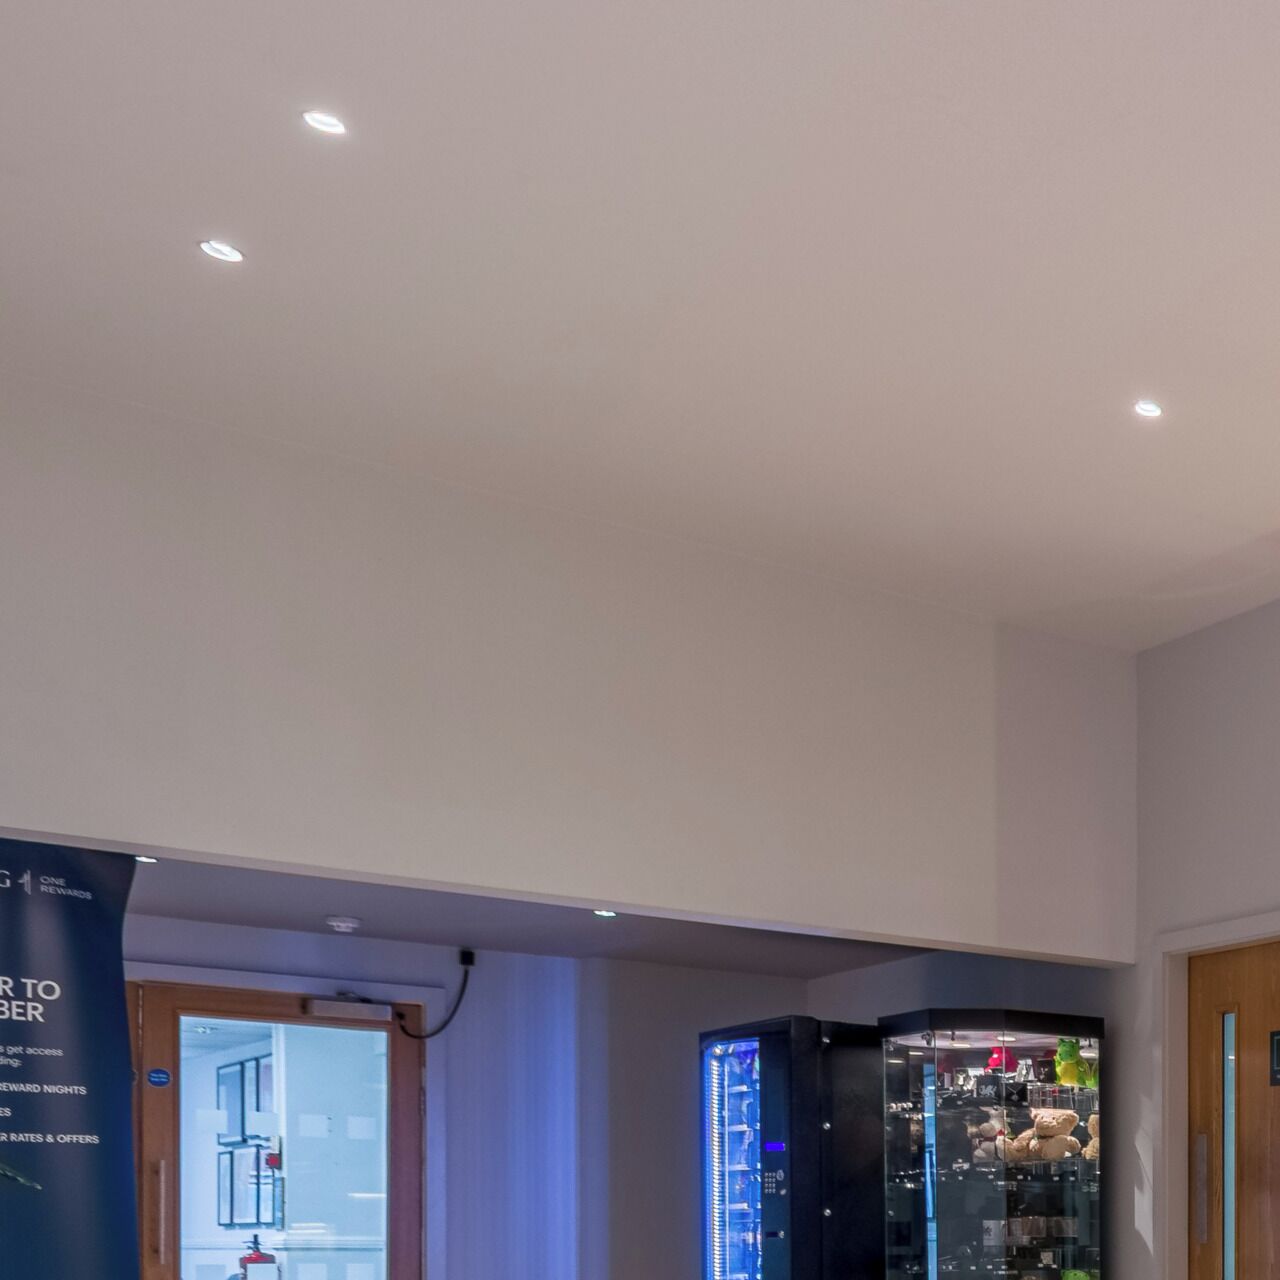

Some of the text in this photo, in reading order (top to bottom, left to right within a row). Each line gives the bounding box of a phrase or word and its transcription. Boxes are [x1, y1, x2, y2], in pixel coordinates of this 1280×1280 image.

[40, 875, 66, 886] ONE
[40, 886, 93, 900] REWARDS
[20, 978, 62, 1000] TO
[6, 1046, 23, 1055] get
[26, 1047, 64, 1057] access
[43, 1085, 87, 1096] NIGHTS
[10, 1133, 44, 1143] RATES
[45, 1134, 54, 1143] &
[56, 1134, 100, 1145] OFFERS
